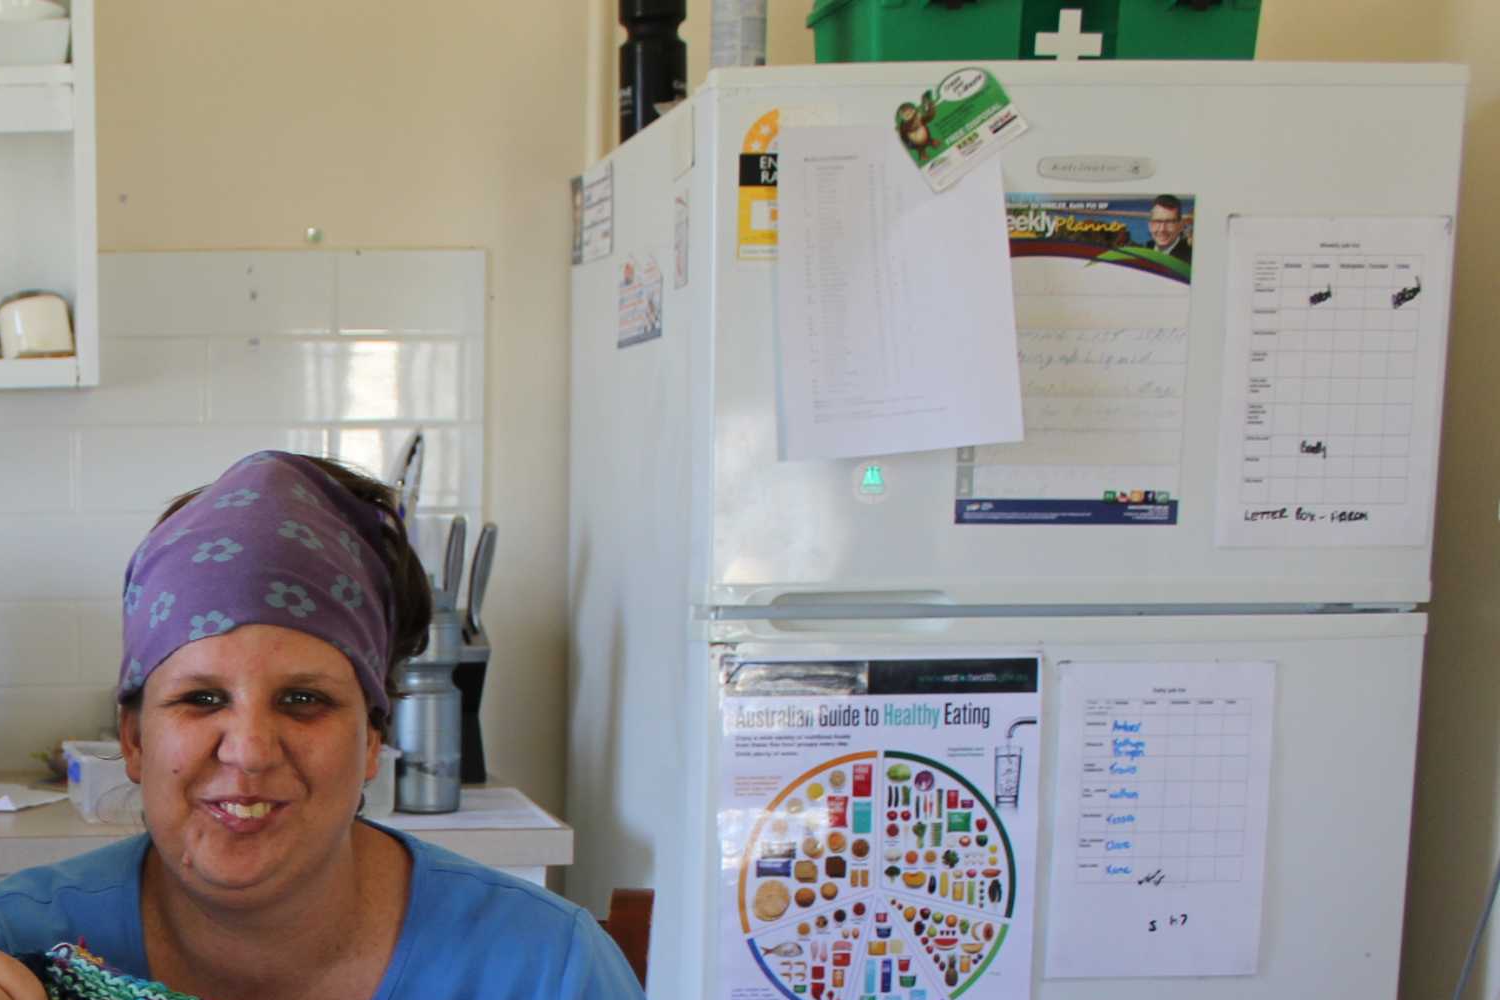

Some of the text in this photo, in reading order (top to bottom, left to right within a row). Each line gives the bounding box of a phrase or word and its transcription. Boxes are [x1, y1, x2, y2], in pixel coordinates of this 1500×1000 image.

[1006, 209, 1127, 238] eekly Planner
[1244, 508, 1288, 521] LETTER
[734, 702, 991, 729] Australian Guide to Healthy Eating
